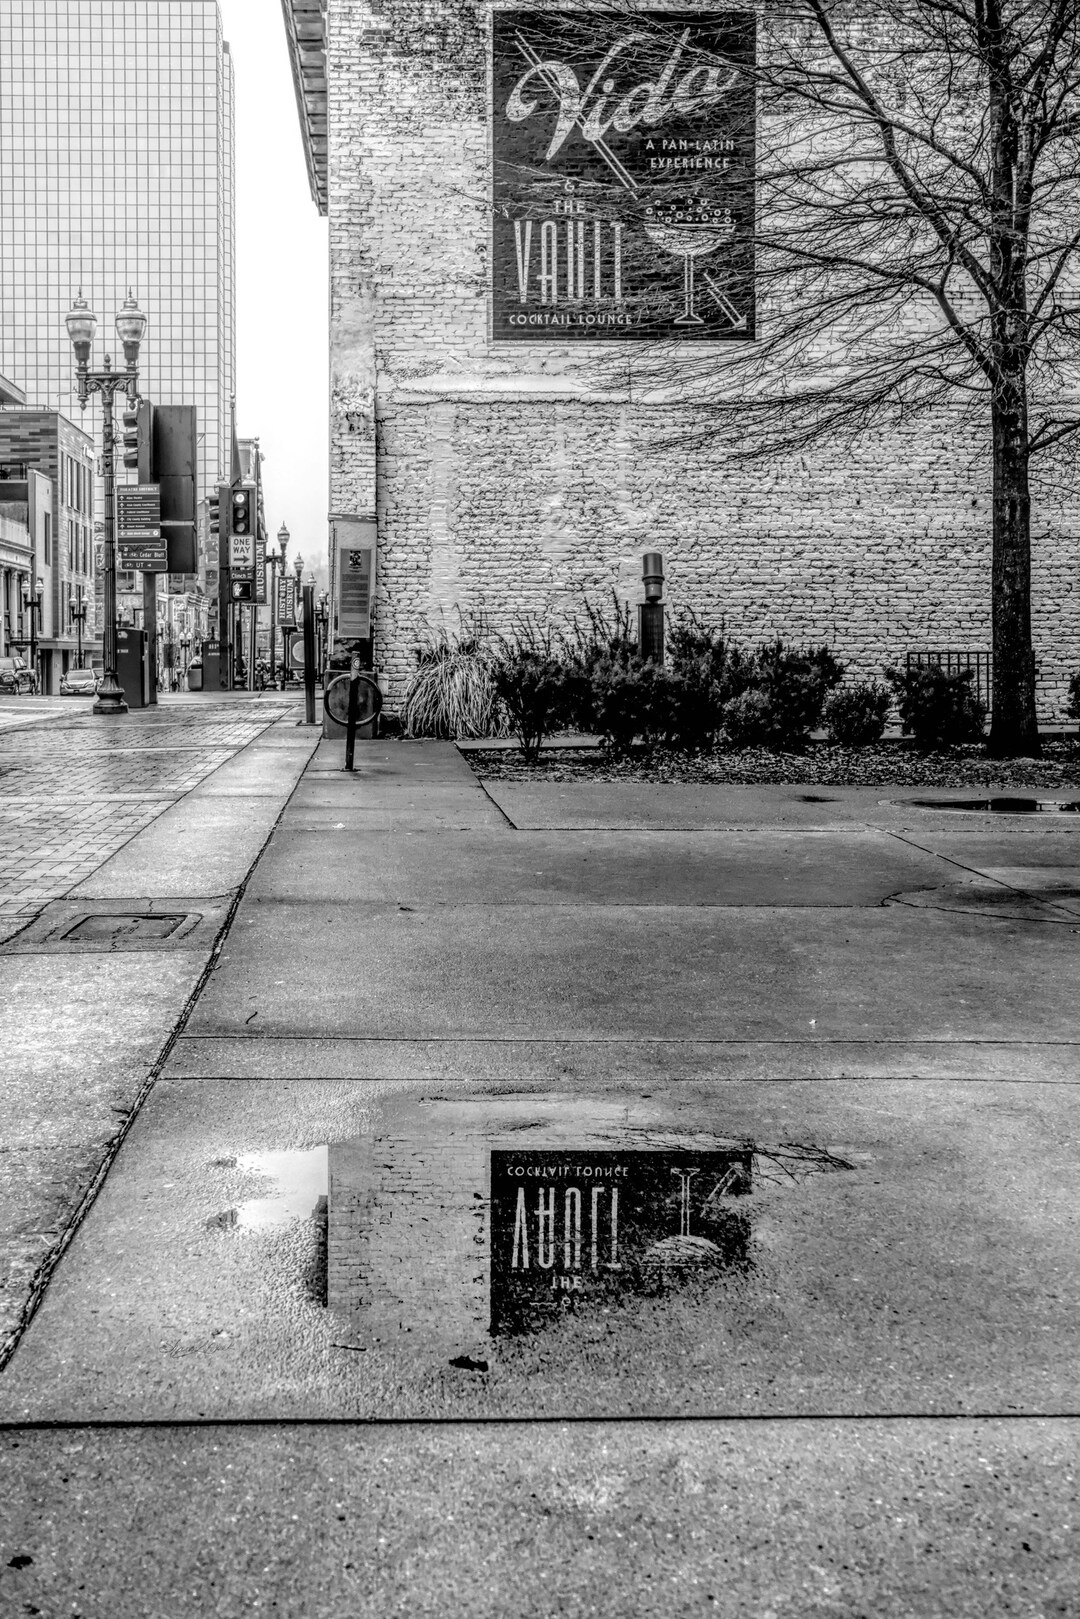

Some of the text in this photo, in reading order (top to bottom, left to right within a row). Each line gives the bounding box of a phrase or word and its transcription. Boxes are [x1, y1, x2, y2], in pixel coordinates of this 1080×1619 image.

[646, 139, 735, 150] A PAN-LATIN
[650, 157, 730, 168] EXPERIENCE
[553, 200, 586, 213] THE
[509, 314, 632, 325] COCKTAIL LOUNGE
[233, 538, 250, 546] ONE
[233, 546, 251, 554] WAY
[256, 543, 265, 596] MUSEUM
[286, 579, 294, 619] MUSEUM
